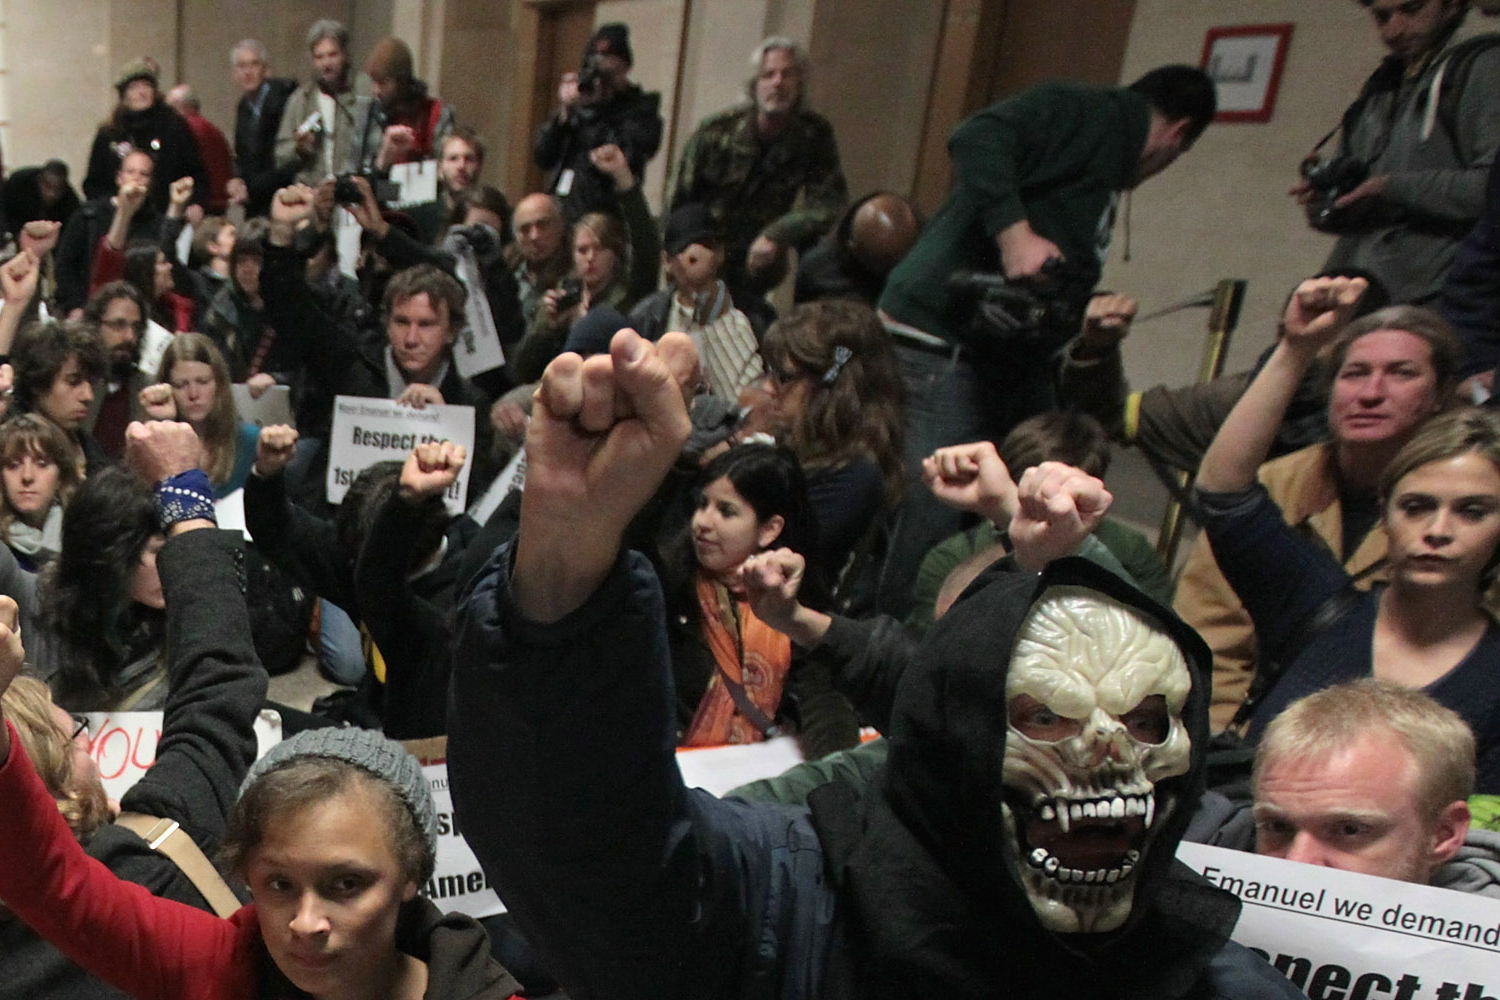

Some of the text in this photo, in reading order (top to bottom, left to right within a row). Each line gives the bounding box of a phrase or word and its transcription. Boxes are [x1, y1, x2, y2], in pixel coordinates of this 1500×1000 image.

[352, 426, 417, 450] Respect
[1201, 866, 1326, 912] Emanuel
[1334, 896, 1373, 921] we
